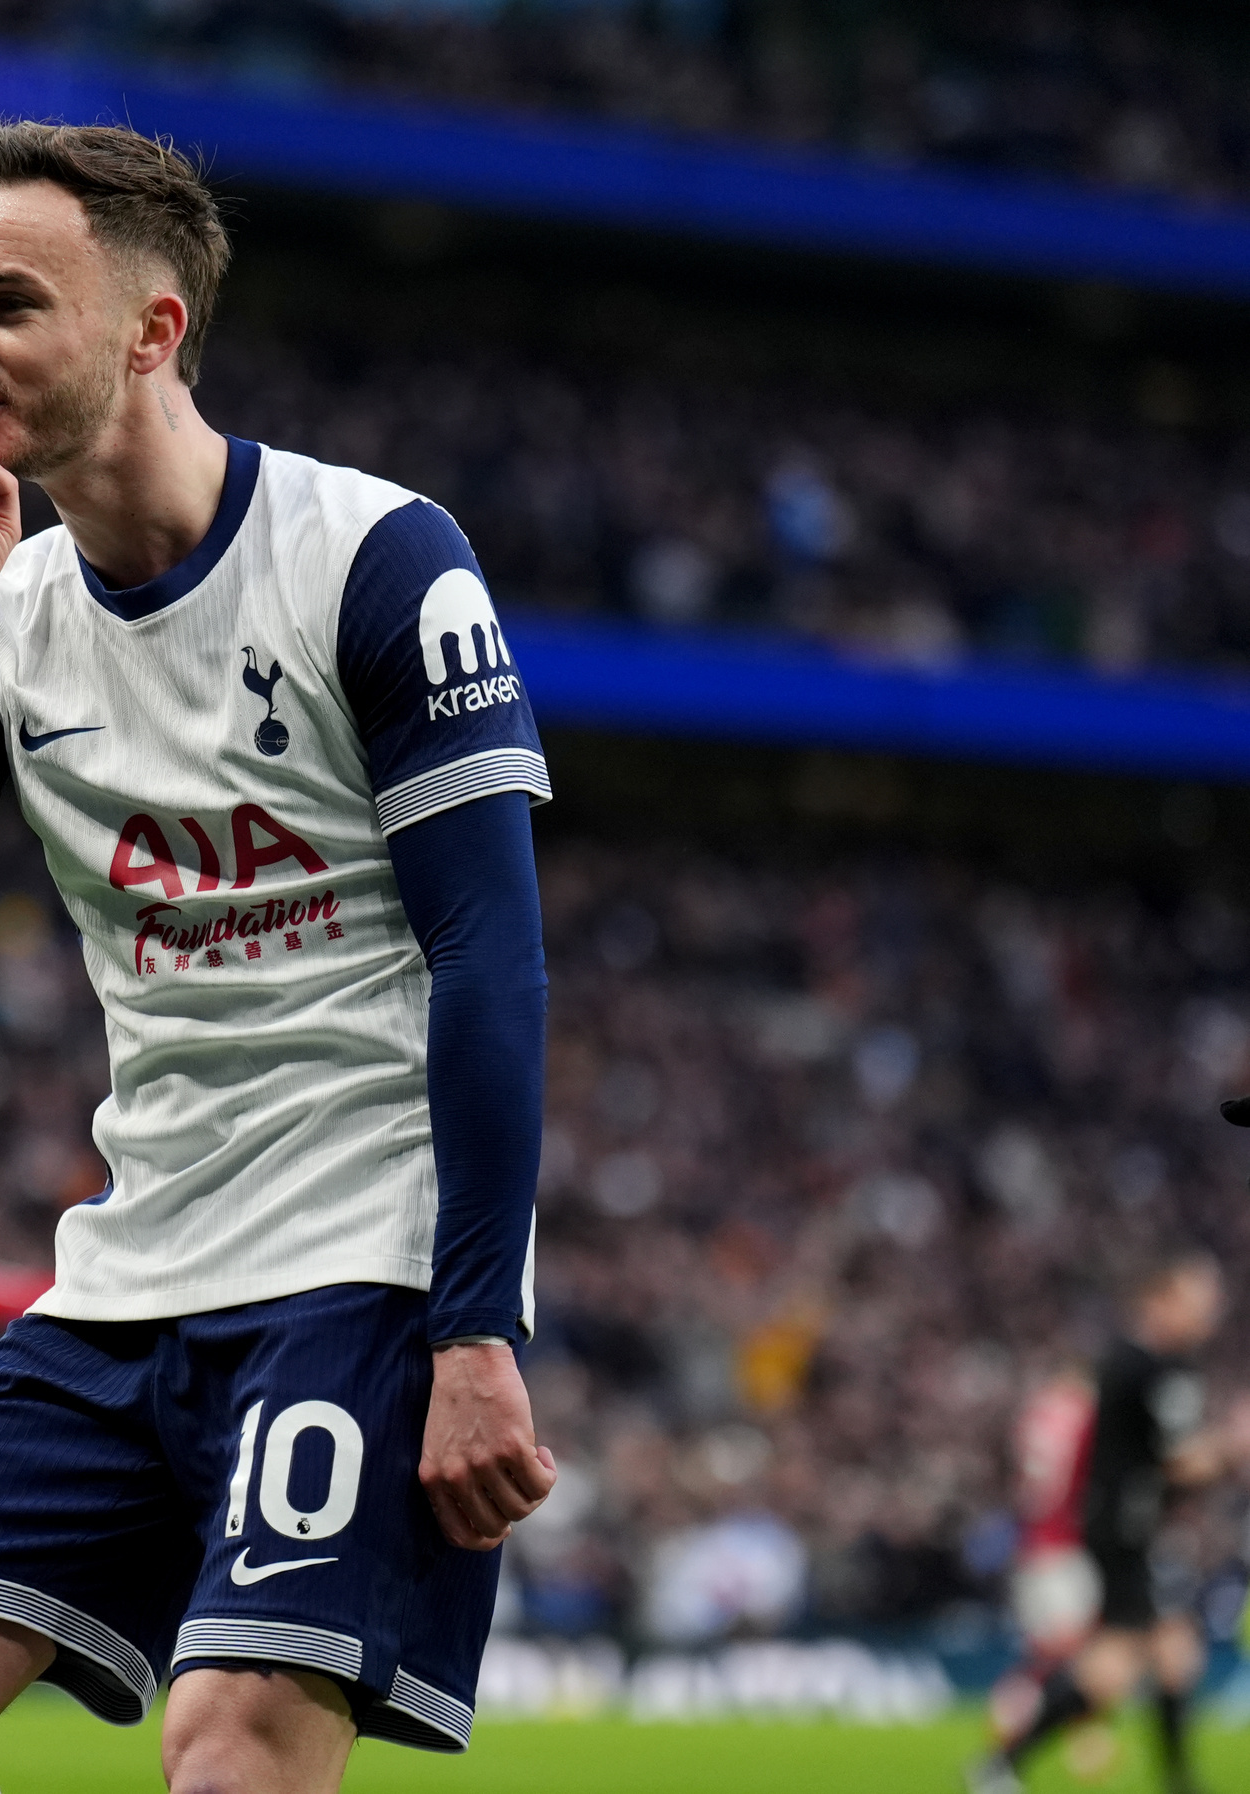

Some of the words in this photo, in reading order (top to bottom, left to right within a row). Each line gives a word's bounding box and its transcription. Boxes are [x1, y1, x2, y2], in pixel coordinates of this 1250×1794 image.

[109, 803, 329, 900] AIA
[135, 890, 340, 976] Foundation
[144, 921, 344, 975] 友邦慈善基金
[225, 1399, 364, 1540] 10
